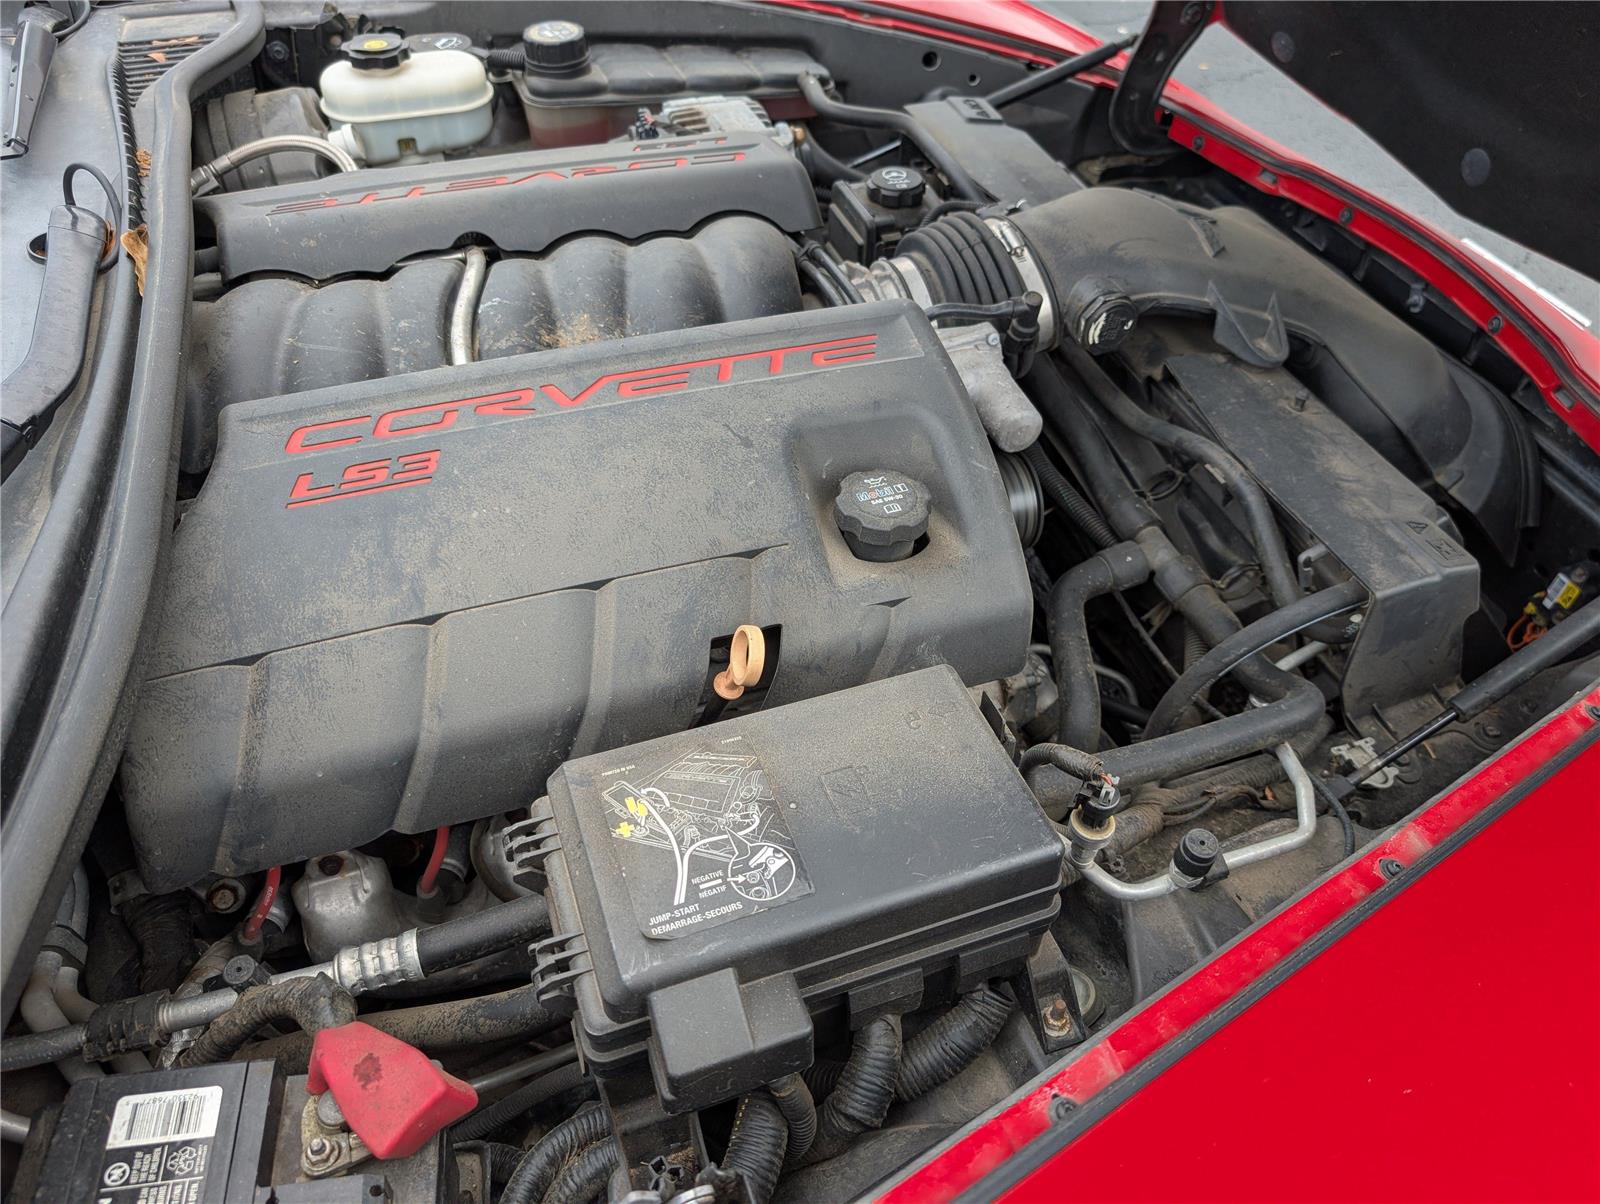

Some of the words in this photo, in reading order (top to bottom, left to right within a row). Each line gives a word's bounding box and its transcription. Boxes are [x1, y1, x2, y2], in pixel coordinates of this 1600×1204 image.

[265, 151, 746, 216] CORVETTE
[285, 333, 878, 455] CORVETTE
[288, 449, 441, 500] LS3
[856, 486, 895, 502] Mobil
[691, 869, 725, 885] NEGATIVE
[648, 902, 701, 926] JUMP-START
[651, 901, 744, 936] DEMARRAGE-SECOURS
[141, 1153, 152, 1171] REACH
[139, 1171, 149, 1183] THE
